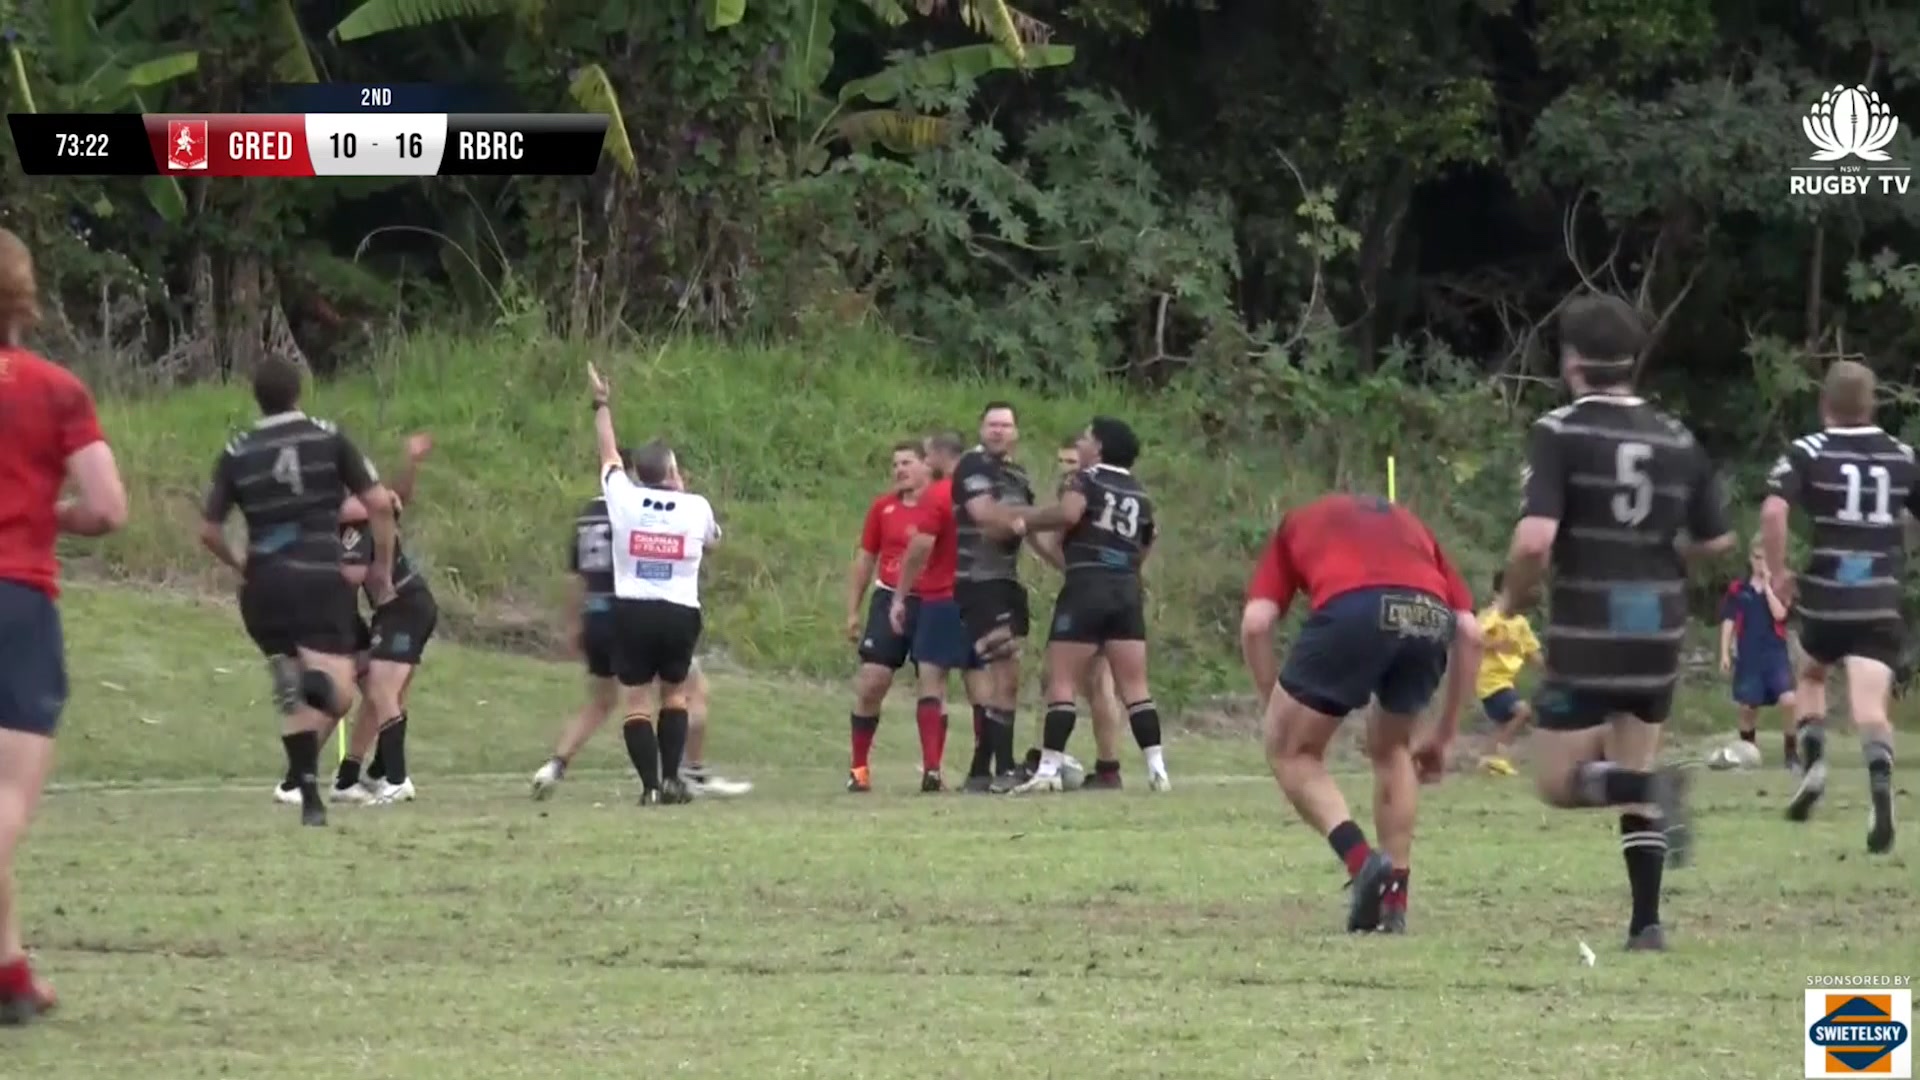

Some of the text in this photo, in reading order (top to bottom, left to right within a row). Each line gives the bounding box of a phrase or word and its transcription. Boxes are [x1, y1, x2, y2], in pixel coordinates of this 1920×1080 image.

[271, 446, 304, 496] 4
[1610, 442, 1654, 527] 5
[1837, 463, 1894, 525] 11
[1092, 492, 1140, 538] 13
